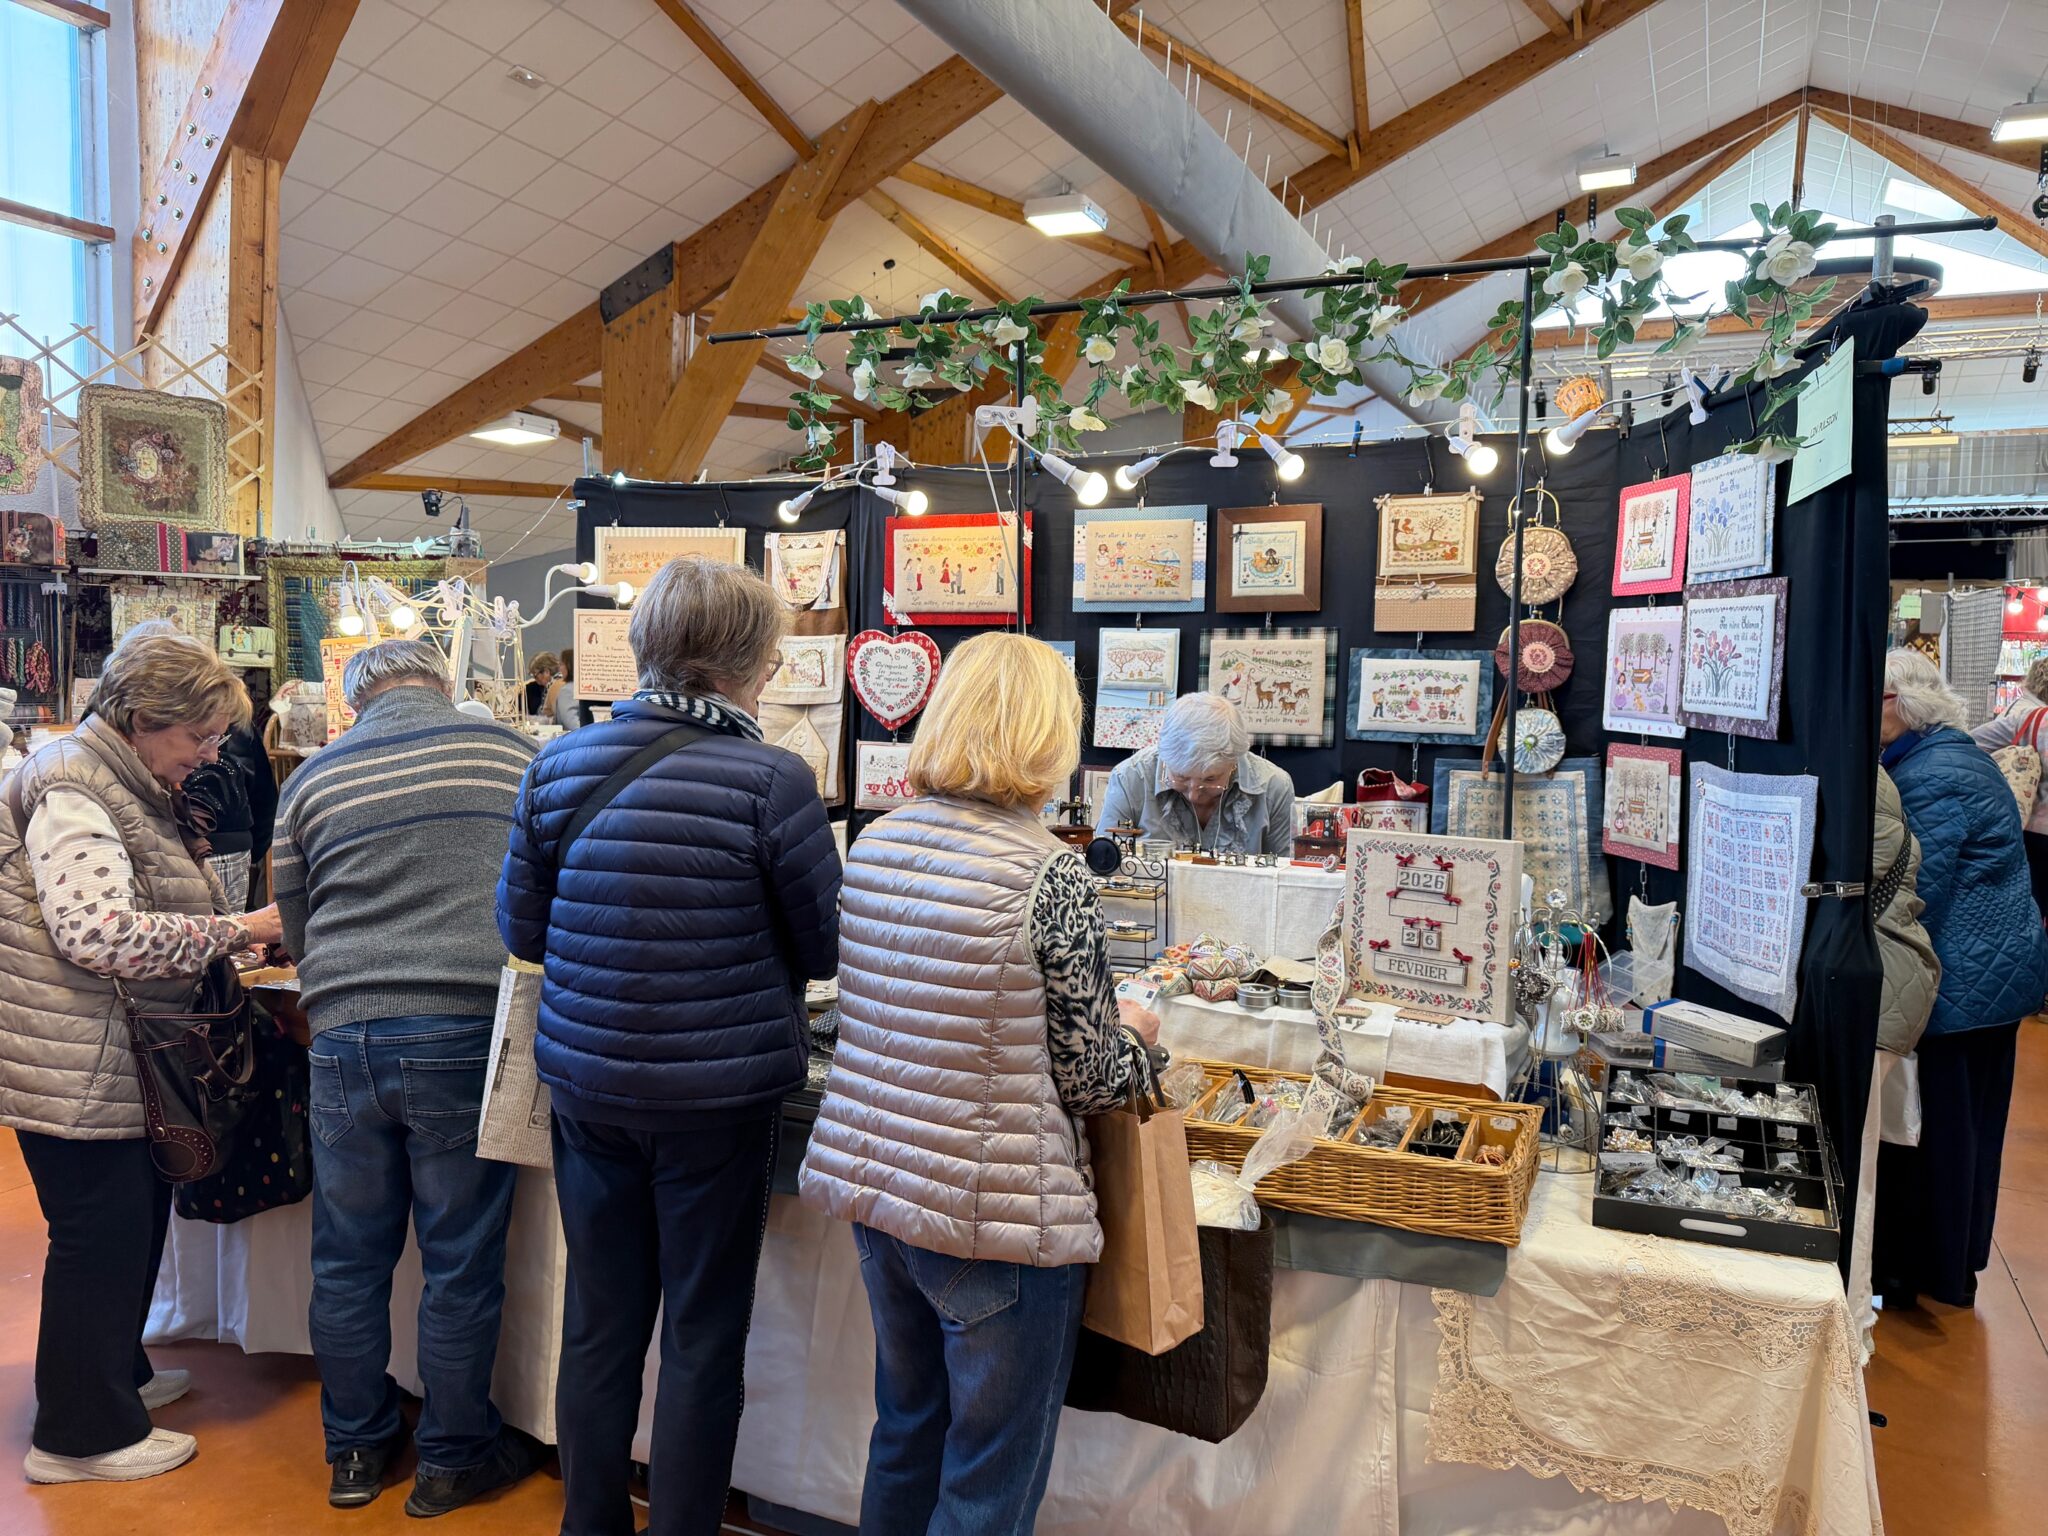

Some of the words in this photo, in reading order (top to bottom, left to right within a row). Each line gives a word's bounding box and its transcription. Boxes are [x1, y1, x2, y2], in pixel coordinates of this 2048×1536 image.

[1385, 807, 1417, 816] CAMPOY
[1399, 871, 1445, 890] 2026
[1388, 958, 1448, 981] FEVRIER
[1118, 983, 1129, 993] 10
